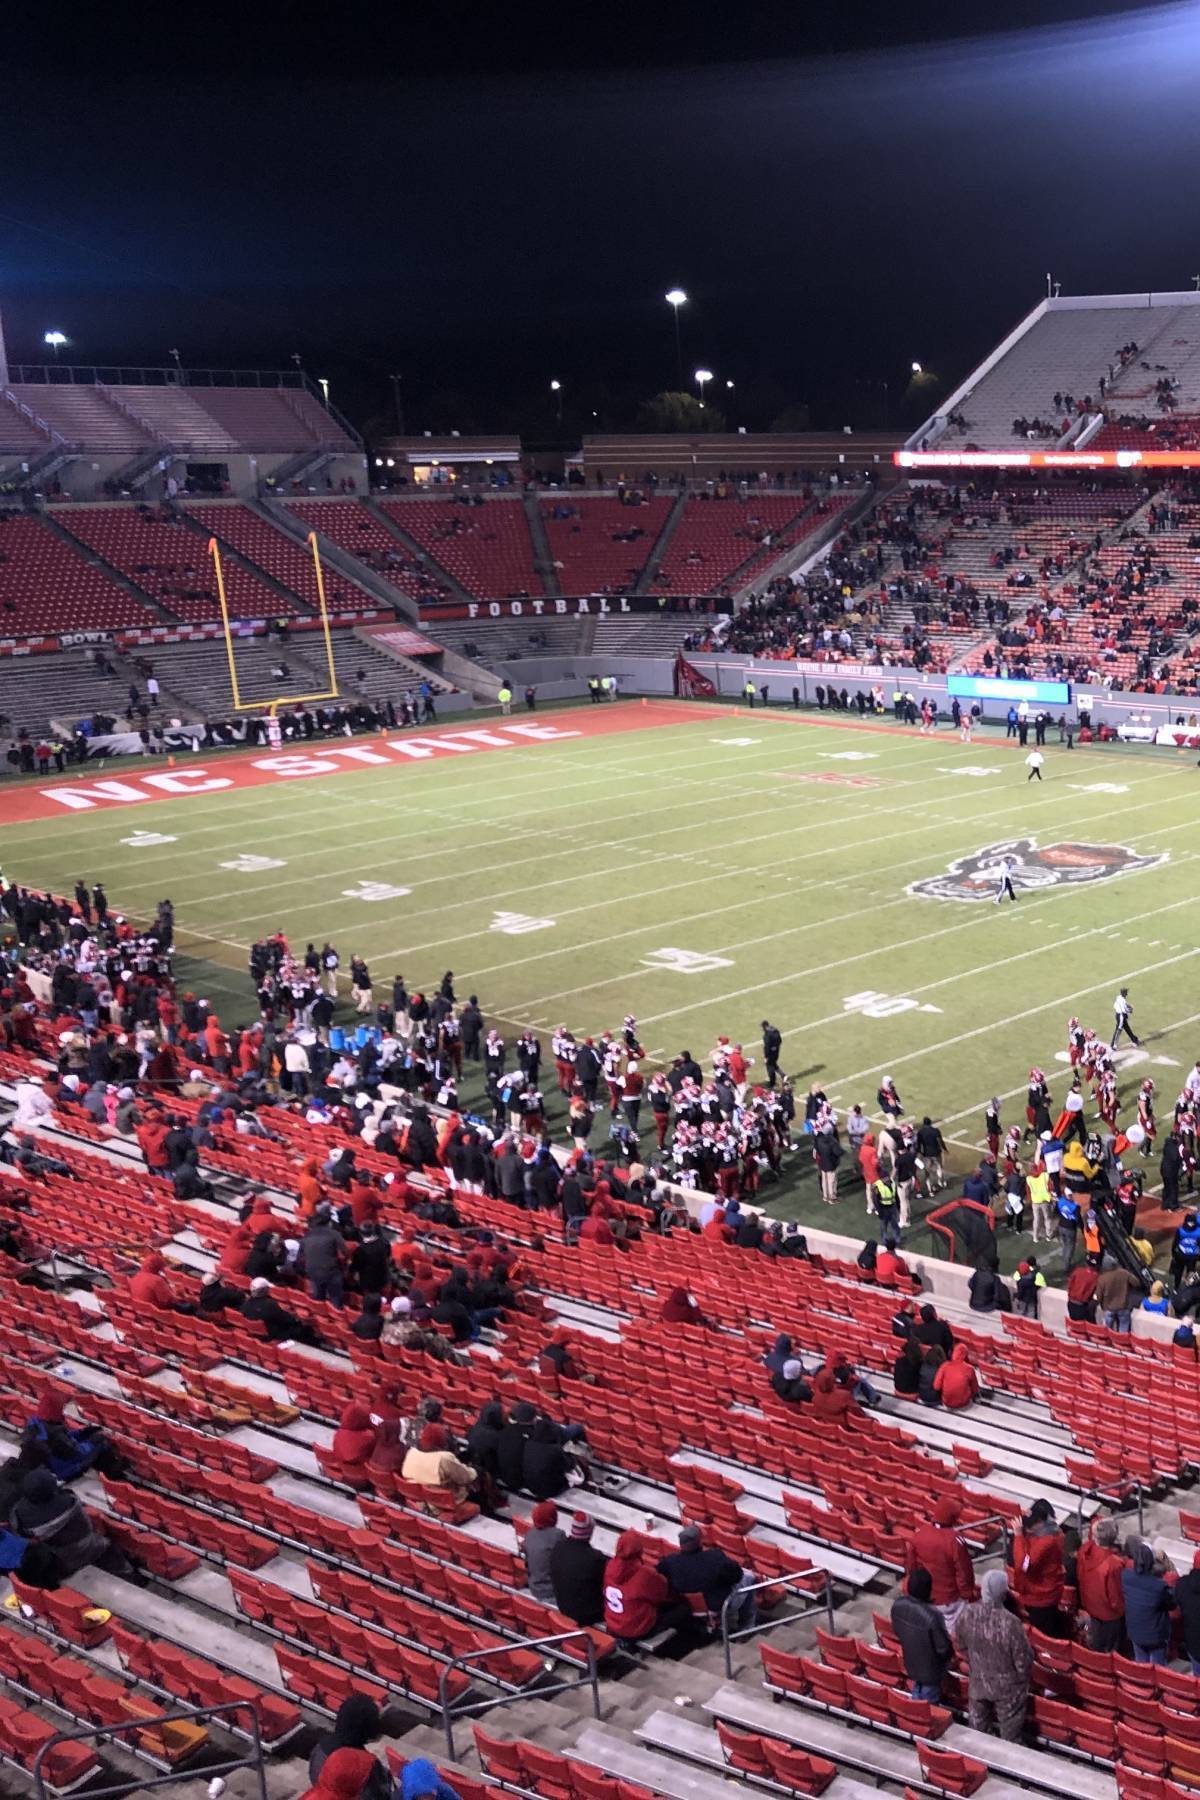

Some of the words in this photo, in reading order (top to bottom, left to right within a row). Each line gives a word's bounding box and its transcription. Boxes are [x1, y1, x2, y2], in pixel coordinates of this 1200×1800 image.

[469, 598, 631, 618] FOOTBALL
[61, 632, 113, 647] BOWL
[40, 769, 234, 810] NC
[251, 722, 584, 777] STATE
[843, 991, 919, 1018] 40
[605, 1586, 624, 1614] S
